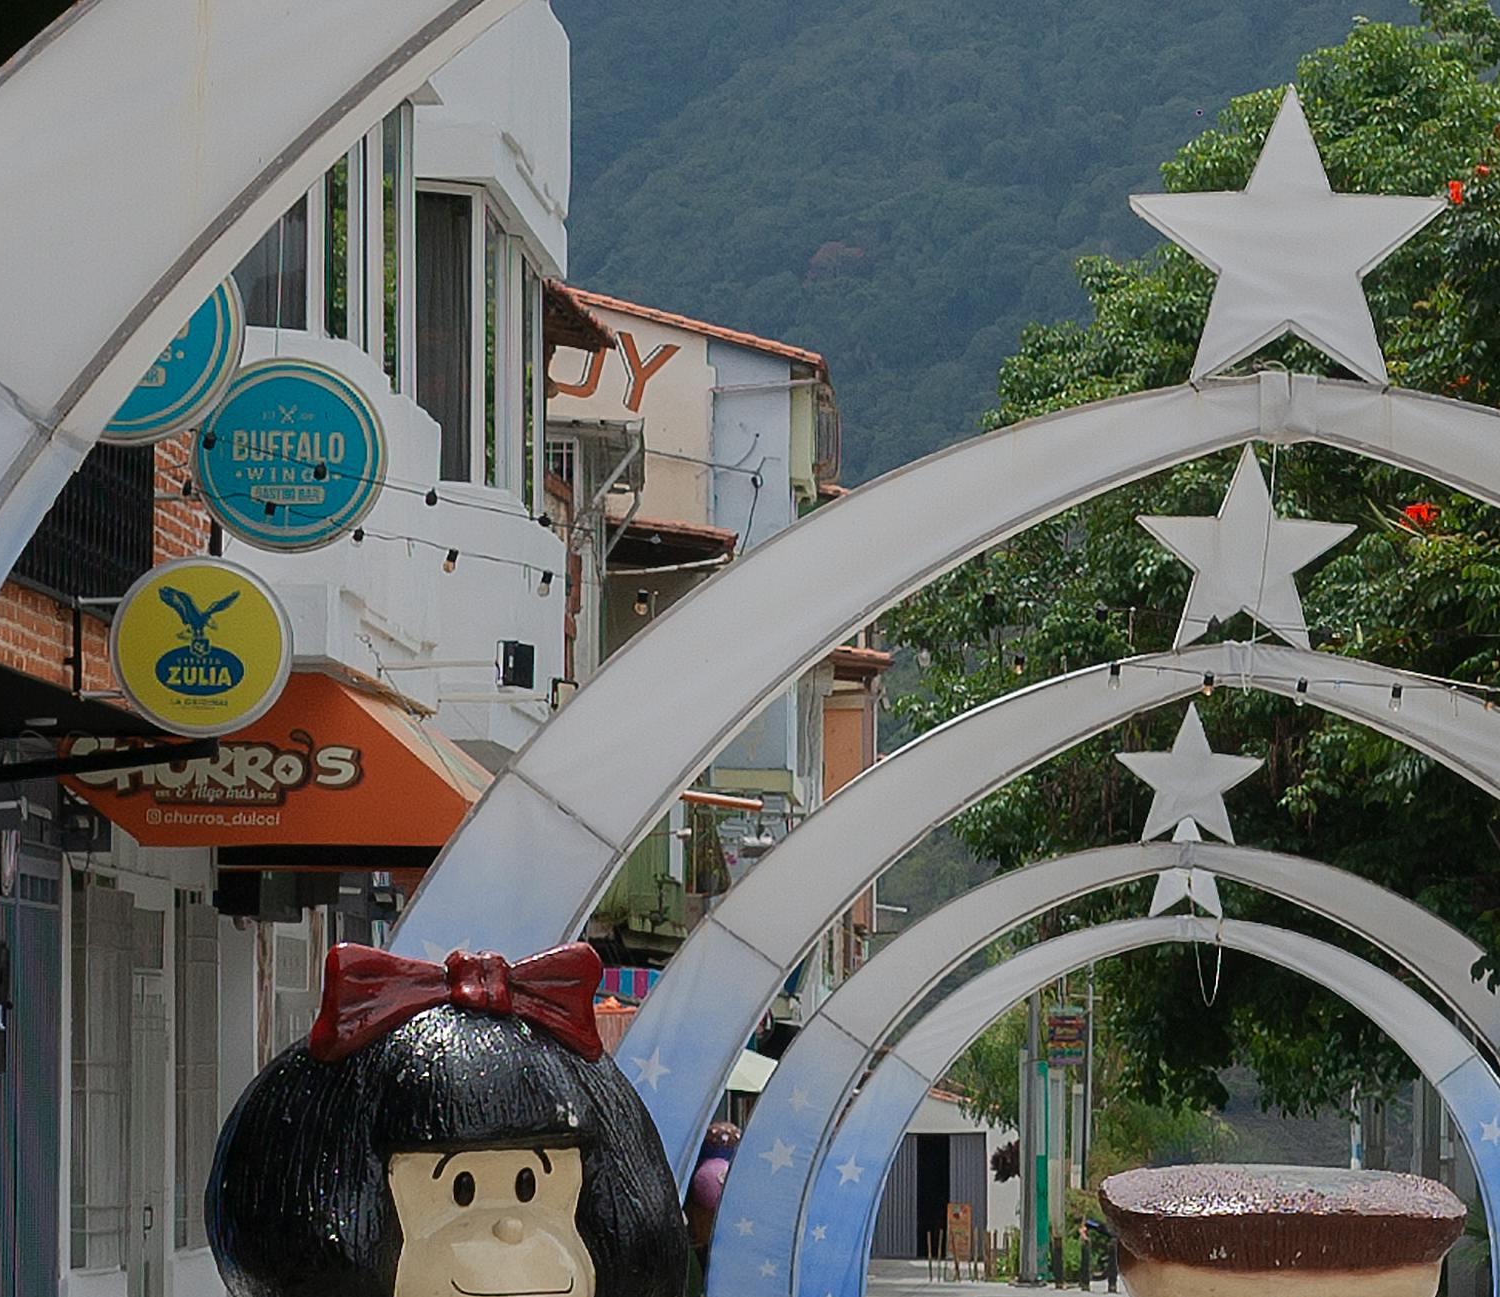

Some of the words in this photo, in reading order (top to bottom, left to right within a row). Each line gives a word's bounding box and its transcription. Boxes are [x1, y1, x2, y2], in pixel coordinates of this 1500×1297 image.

[233, 430, 345, 464] BUFFALO
[247, 467, 330, 483] WING
[166, 666, 232, 686] ZULIA
